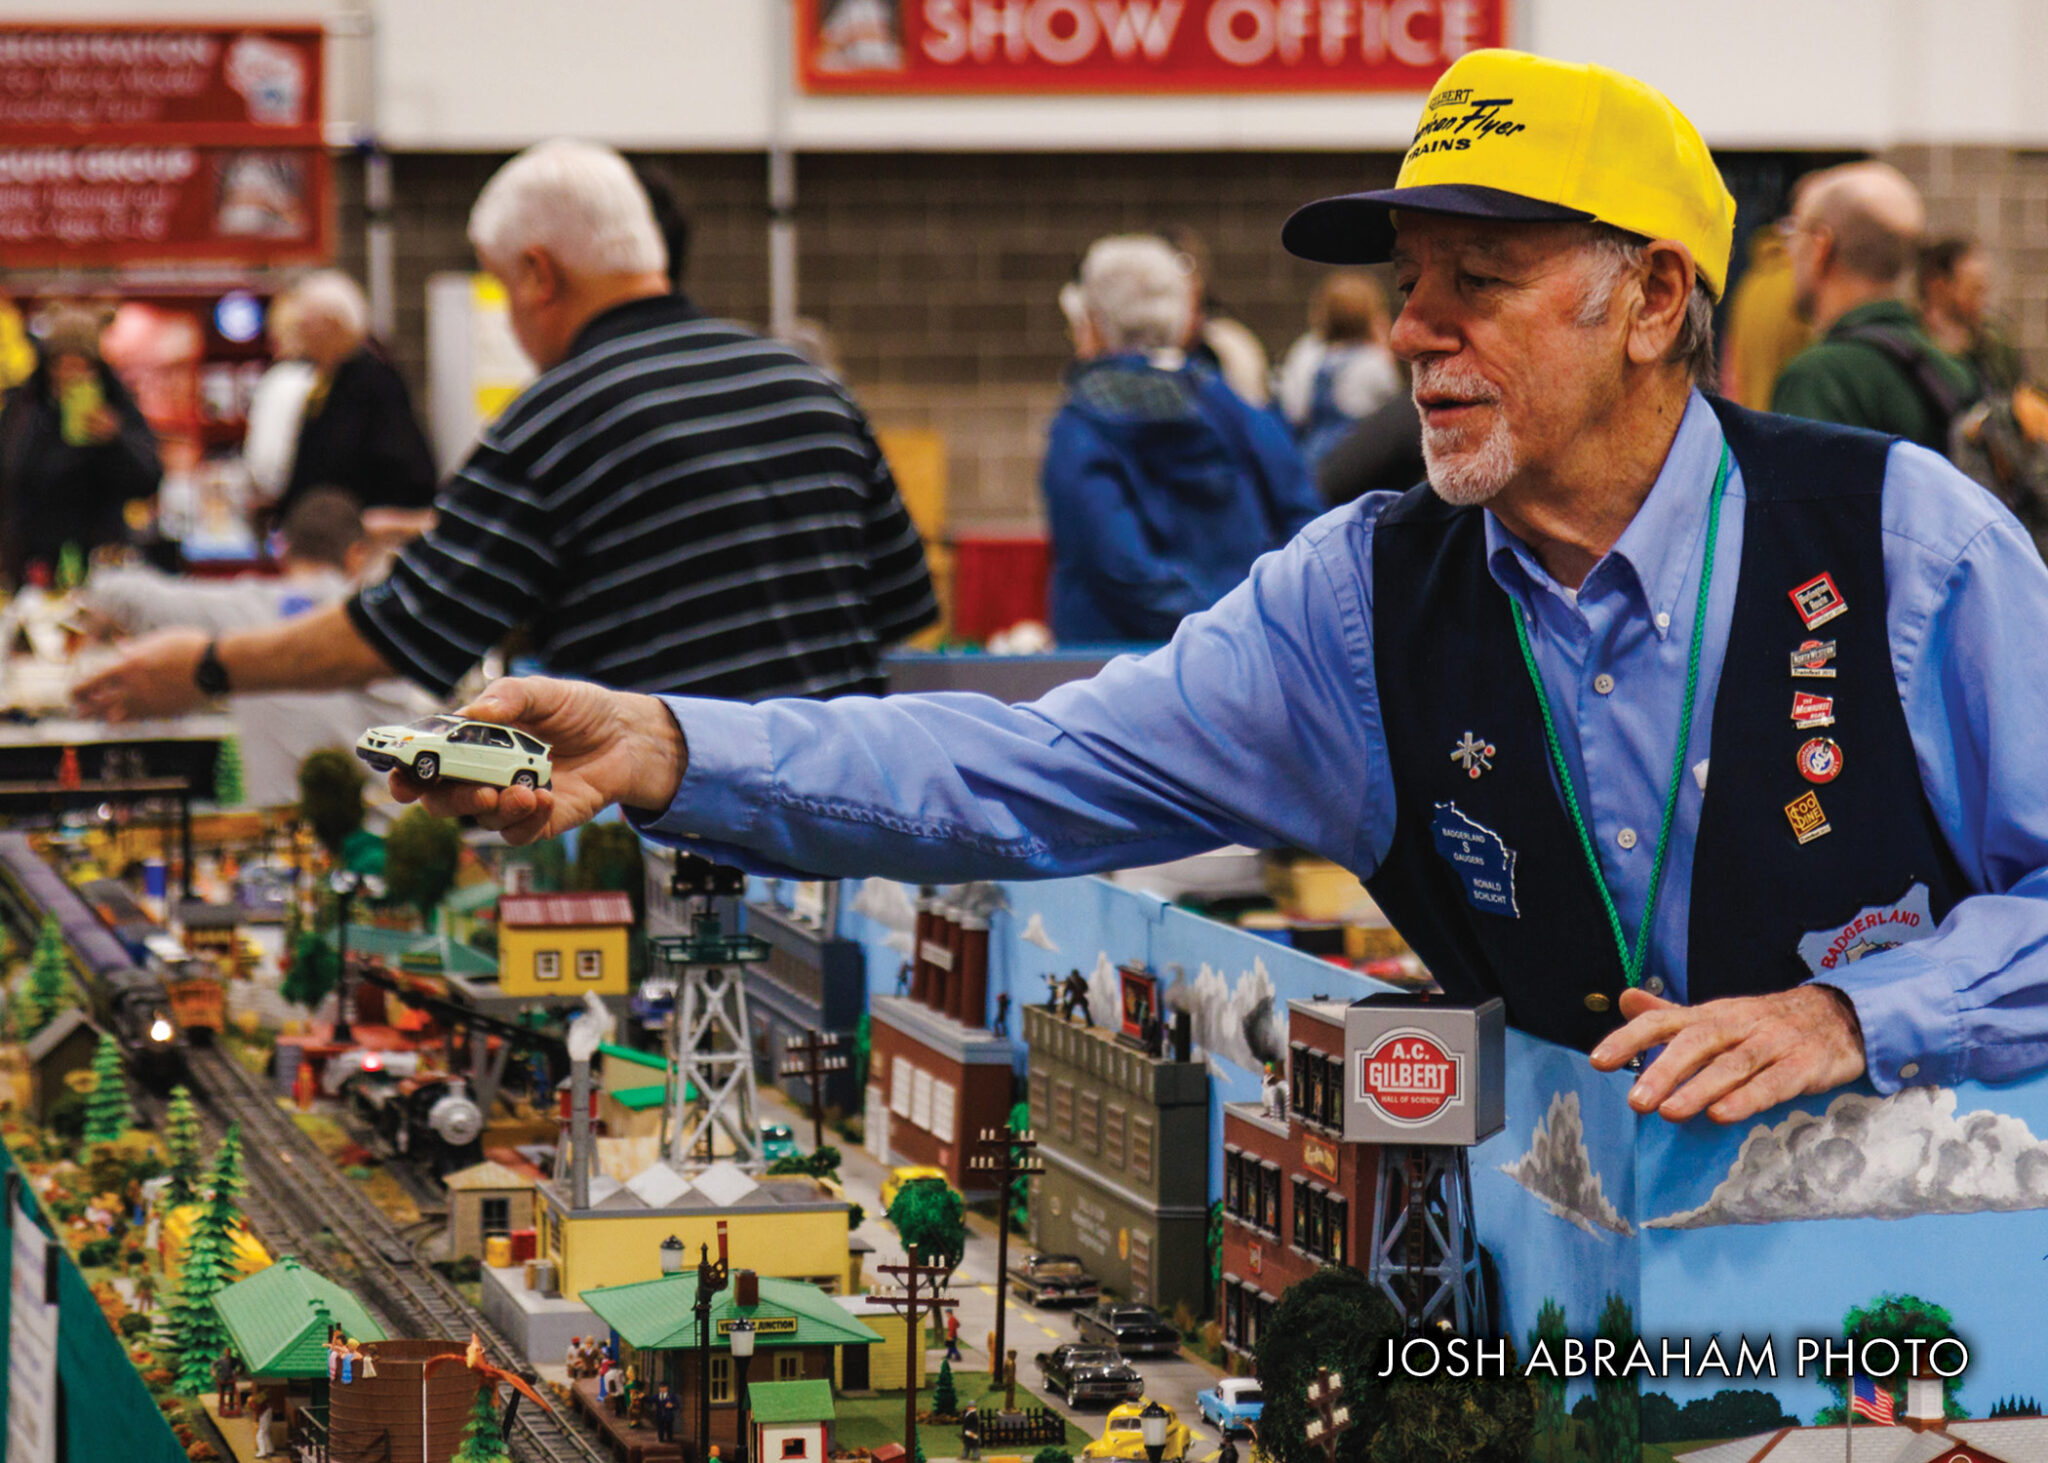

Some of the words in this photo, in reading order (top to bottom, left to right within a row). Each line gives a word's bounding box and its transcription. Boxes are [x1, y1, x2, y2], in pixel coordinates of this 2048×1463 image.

[922, 0, 1186, 65] SHOW
[1206, 0, 1488, 66] OFFICE
[1454, 98, 1526, 140] Flyer
[1442, 827, 1485, 843] BADGERLAND
[1462, 841, 1471, 853] S
[1453, 852, 1485, 866] GAUGERS
[1473, 878, 1502, 892] RONALD
[1821, 909, 1921, 969] BADGERLAND
[1392, 1043, 1430, 1060] A.C.
[1369, 1062, 1449, 1094] GILBERT
[1381, 1096, 1398, 1104] HALL
[1400, 1096, 1409, 1104] OF
[1410, 1096, 1441, 1104] SCIENCE
[758, 1320, 795, 1331] JUNCTION
